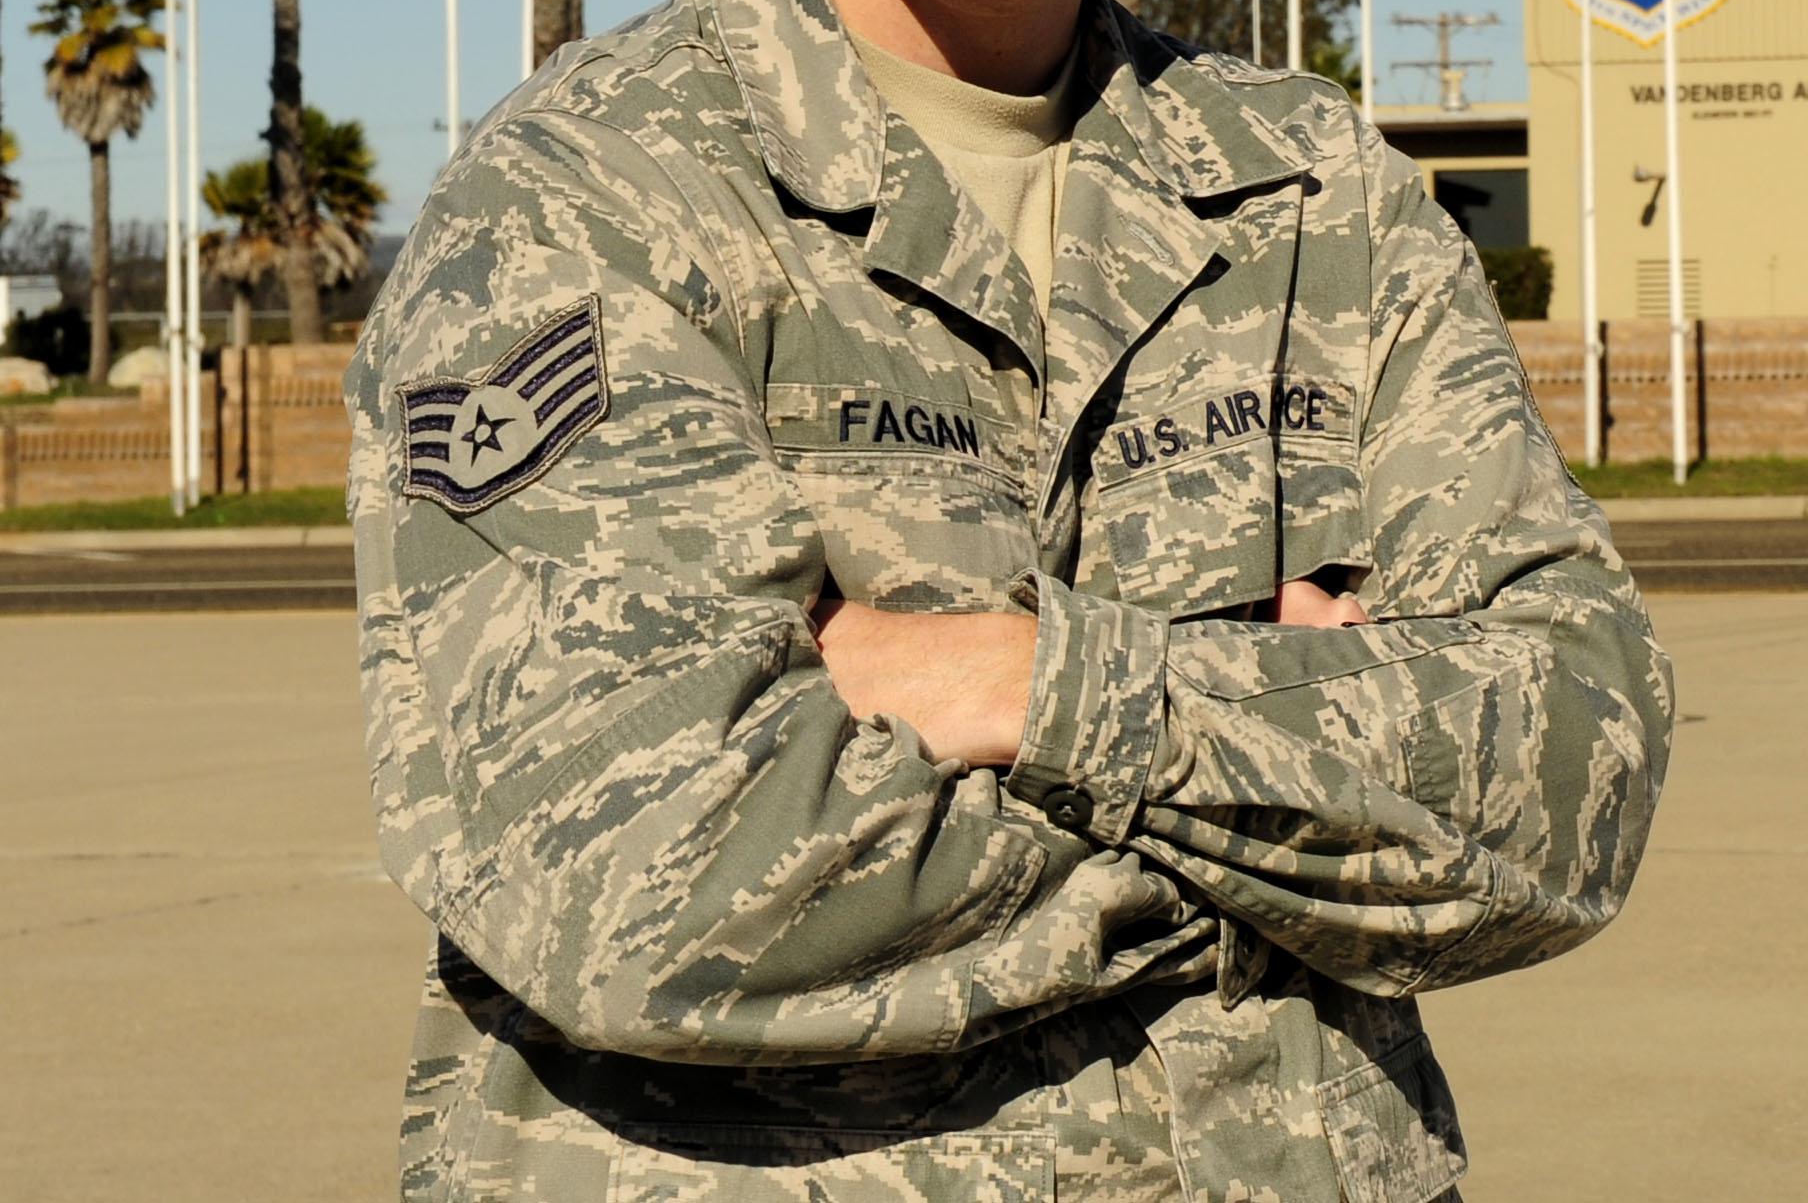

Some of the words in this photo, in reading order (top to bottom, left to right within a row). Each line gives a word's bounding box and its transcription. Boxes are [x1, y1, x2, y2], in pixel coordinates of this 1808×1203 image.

[839, 400, 980, 458] FAGAN
[1117, 418, 1190, 469] U.S.
[1206, 390, 1266, 444] AIR
